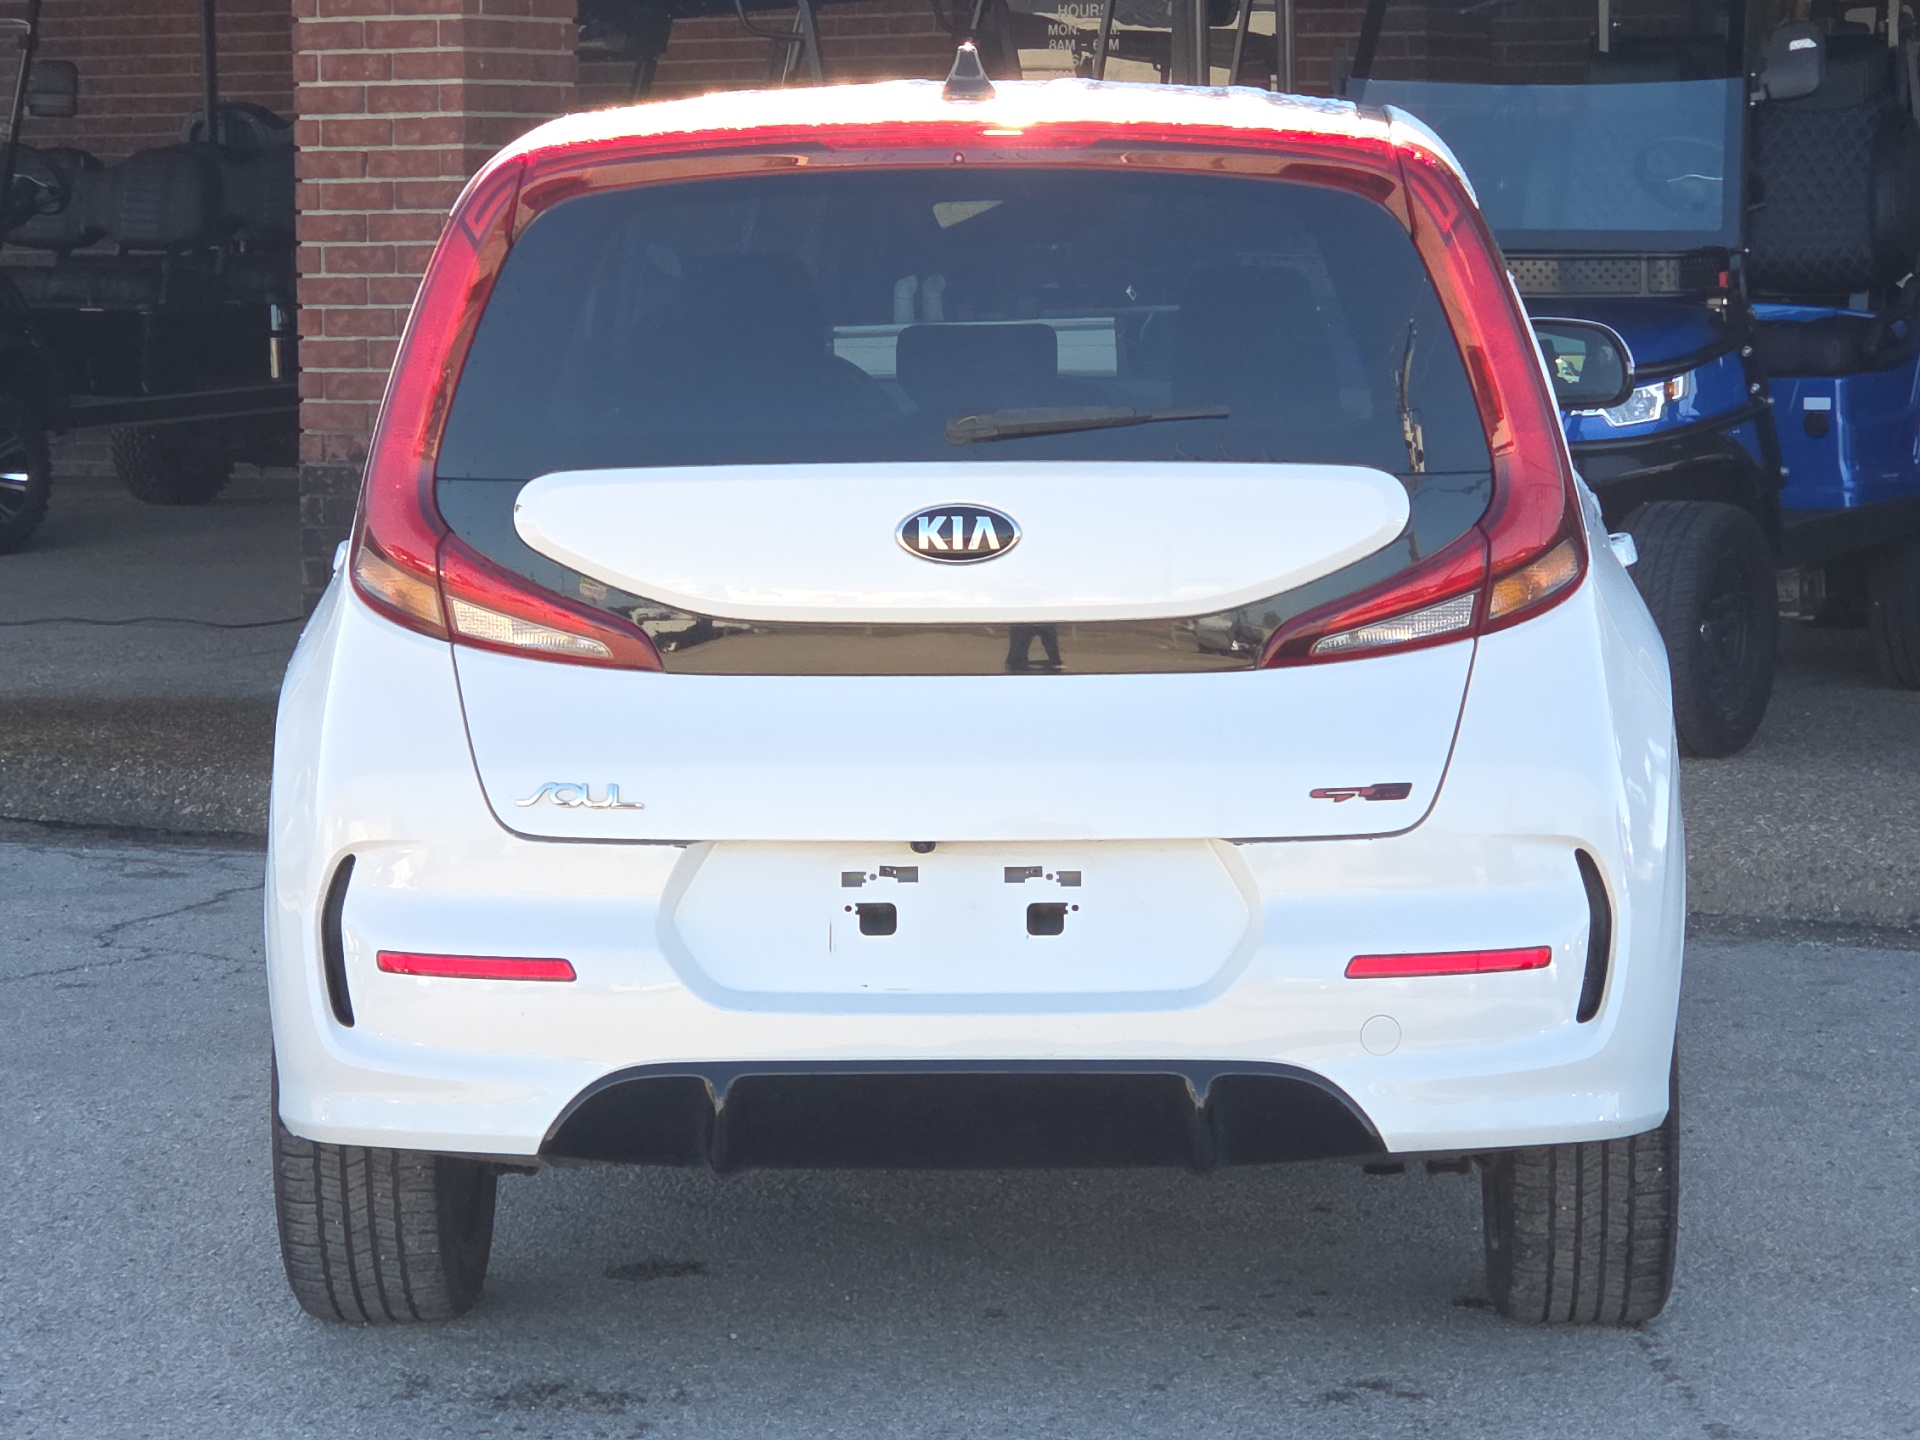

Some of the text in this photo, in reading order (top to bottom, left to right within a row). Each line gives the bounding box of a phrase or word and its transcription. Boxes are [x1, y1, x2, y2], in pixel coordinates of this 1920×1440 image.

[1048, 23, 1080, 36] MON.
[1048, 38, 1076, 51] 8AM
[917, 515, 1000, 550] KIA
